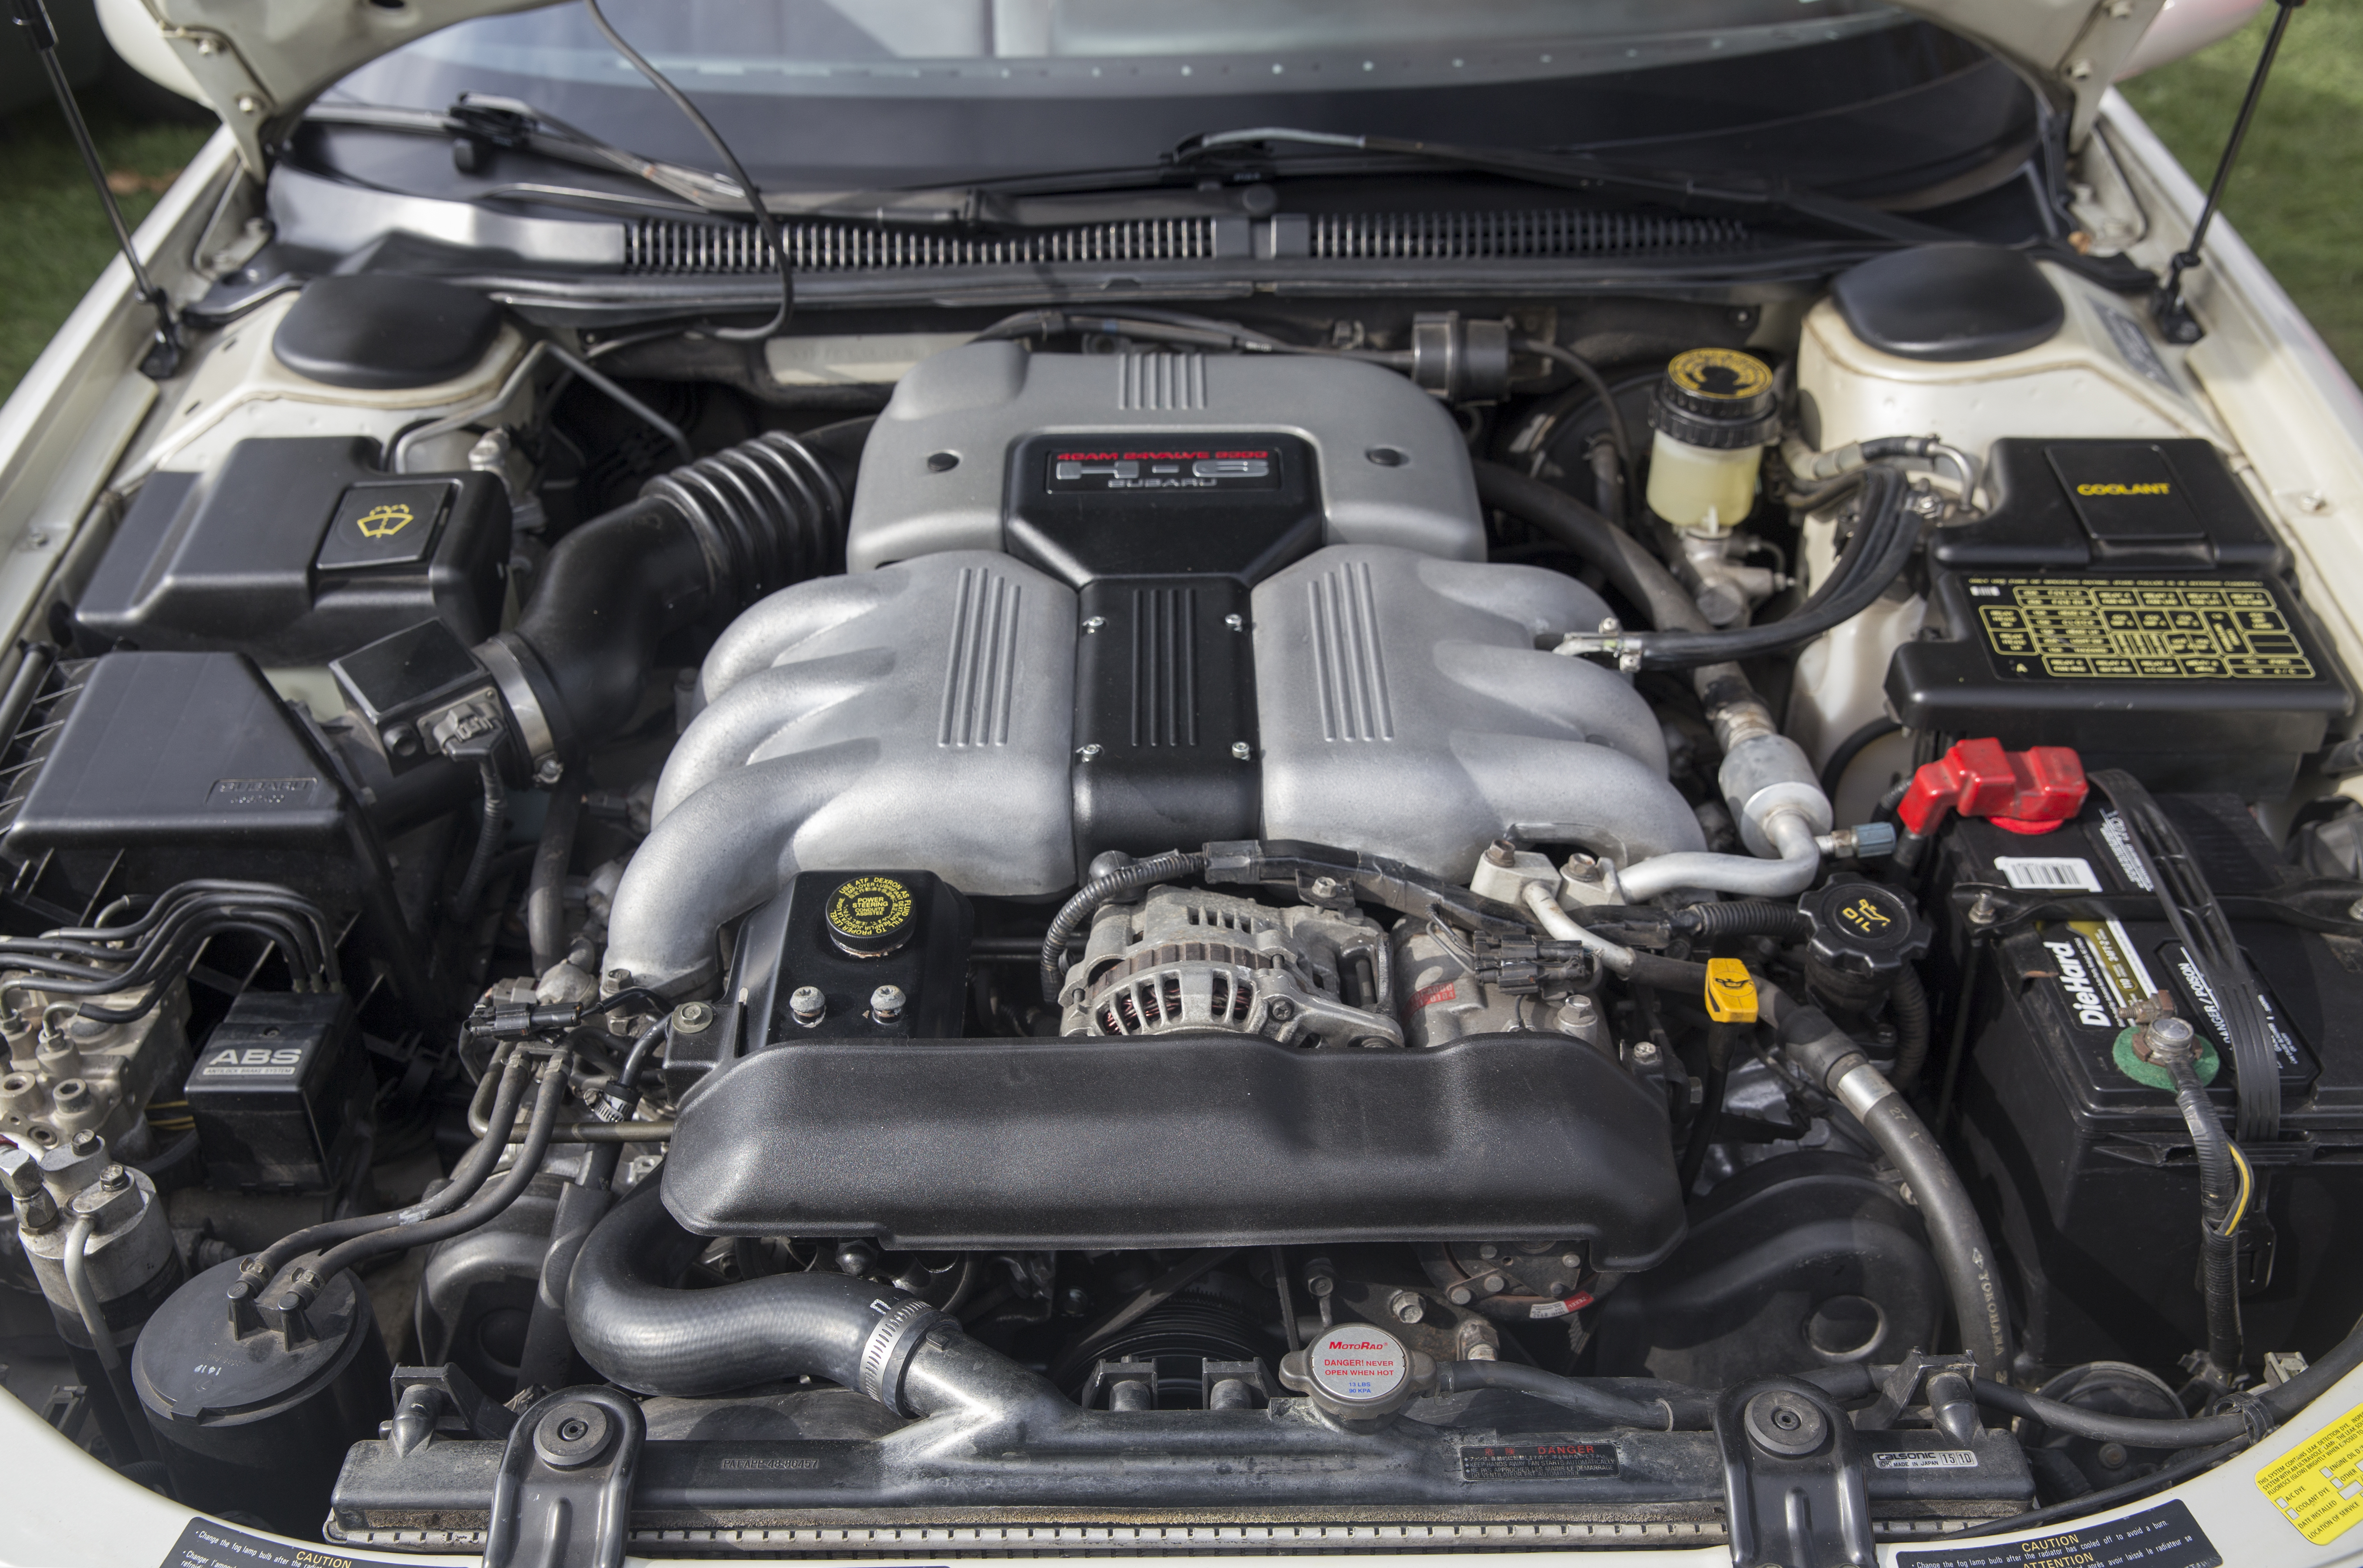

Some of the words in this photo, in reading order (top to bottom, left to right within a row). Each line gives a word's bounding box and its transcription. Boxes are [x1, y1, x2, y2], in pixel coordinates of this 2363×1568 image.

[1108, 477, 1216, 487] SUBARU
[2077, 483, 2170, 496] COOLANT
[839, 883, 853, 894] USE
[874, 877, 902, 890] DEXRON
[901, 900, 911, 916] FLUID
[830, 910, 843, 926] LEVEL
[888, 918, 903, 927] FILL
[1843, 907, 1870, 932] OIL
[842, 926, 872, 935] PROPER
[2043, 941, 2111, 1027] DieHard
[2178, 963, 2208, 997] POISON
[209, 1049, 302, 1065] ABS
[1569, 1296, 1587, 1308] ZEXEL
[1978, 1269, 2004, 1356] YOKOHAMA
[1538, 1445, 1594, 1454] DANGER
[2257, 1477, 2269, 1486] THIS
[2268, 1465, 2286, 1478] SYSTEM
[2285, 1452, 2307, 1468] CONTAINS
[2306, 1444, 2318, 1454] LEAK
[2317, 1429, 2340, 1446] DETECTION
[2340, 1423, 2350, 1431] DYE.
[1941, 1454, 1955, 1464] 15
[2262, 1478, 2280, 1491] SYSTEM
[2278, 1469, 2291, 1481] WITH
[2344, 1426, 2356, 1435] LEAK
[2267, 1479, 2292, 1496] FLUORESCE
[2290, 1467, 2308, 1481] (GLOW)
[2306, 1455, 2327, 1470] BRIGHTLY
[2326, 1445, 2340, 1456] WHEN
[2338, 1434, 2357, 1448] EXPOSED
[2329, 1457, 2348, 1471] ENGINE
[2340, 1468, 2358, 1482] OTHER
[2285, 1493, 2296, 1502] A/C
[2294, 1485, 2306, 1495] DYE
[2295, 1494, 2320, 1512] COOLANT
[2318, 1487, 2331, 1498] DYE
[2297, 1517, 2312, 1529] DATE
[2311, 1500, 2338, 1519] INSTALLED
[2307, 1520, 2333, 1539] LOCATION
[2331, 1512, 2340, 1521] OF
[2339, 1502, 2360, 1516] SERVICE
[199, 1531, 219, 1544] Change
[220, 1539, 230, 1548] the
[232, 1542, 242, 1553] fog
[242, 1546, 257, 1557] lamp
[259, 1551, 272, 1560] bulb
[274, 1556, 289, 1565] after
[1957, 1560, 1968, 1568] fog
[1969, 1557, 1985, 1567] lamp
[2038, 1548, 2063, 1558] radiator
[2080, 1539, 2100, 1550] cooled
[2103, 1536, 2112, 1544] off
[2127, 1528, 2143, 1538] avoid
[2152, 1520, 2169, 1530] burn.
[2022, 1534, 2079, 1552] CAUTION
[186, 1550, 209, 1564] Changer
[296, 1551, 351, 1568] CAUTION
[2024, 1552, 2094, 1568] ATTENTION
[2108, 1557, 2123, 1566] avoir
[2126, 1550, 2144, 1561] laissé
[2156, 1539, 2182, 1552] radiateur
